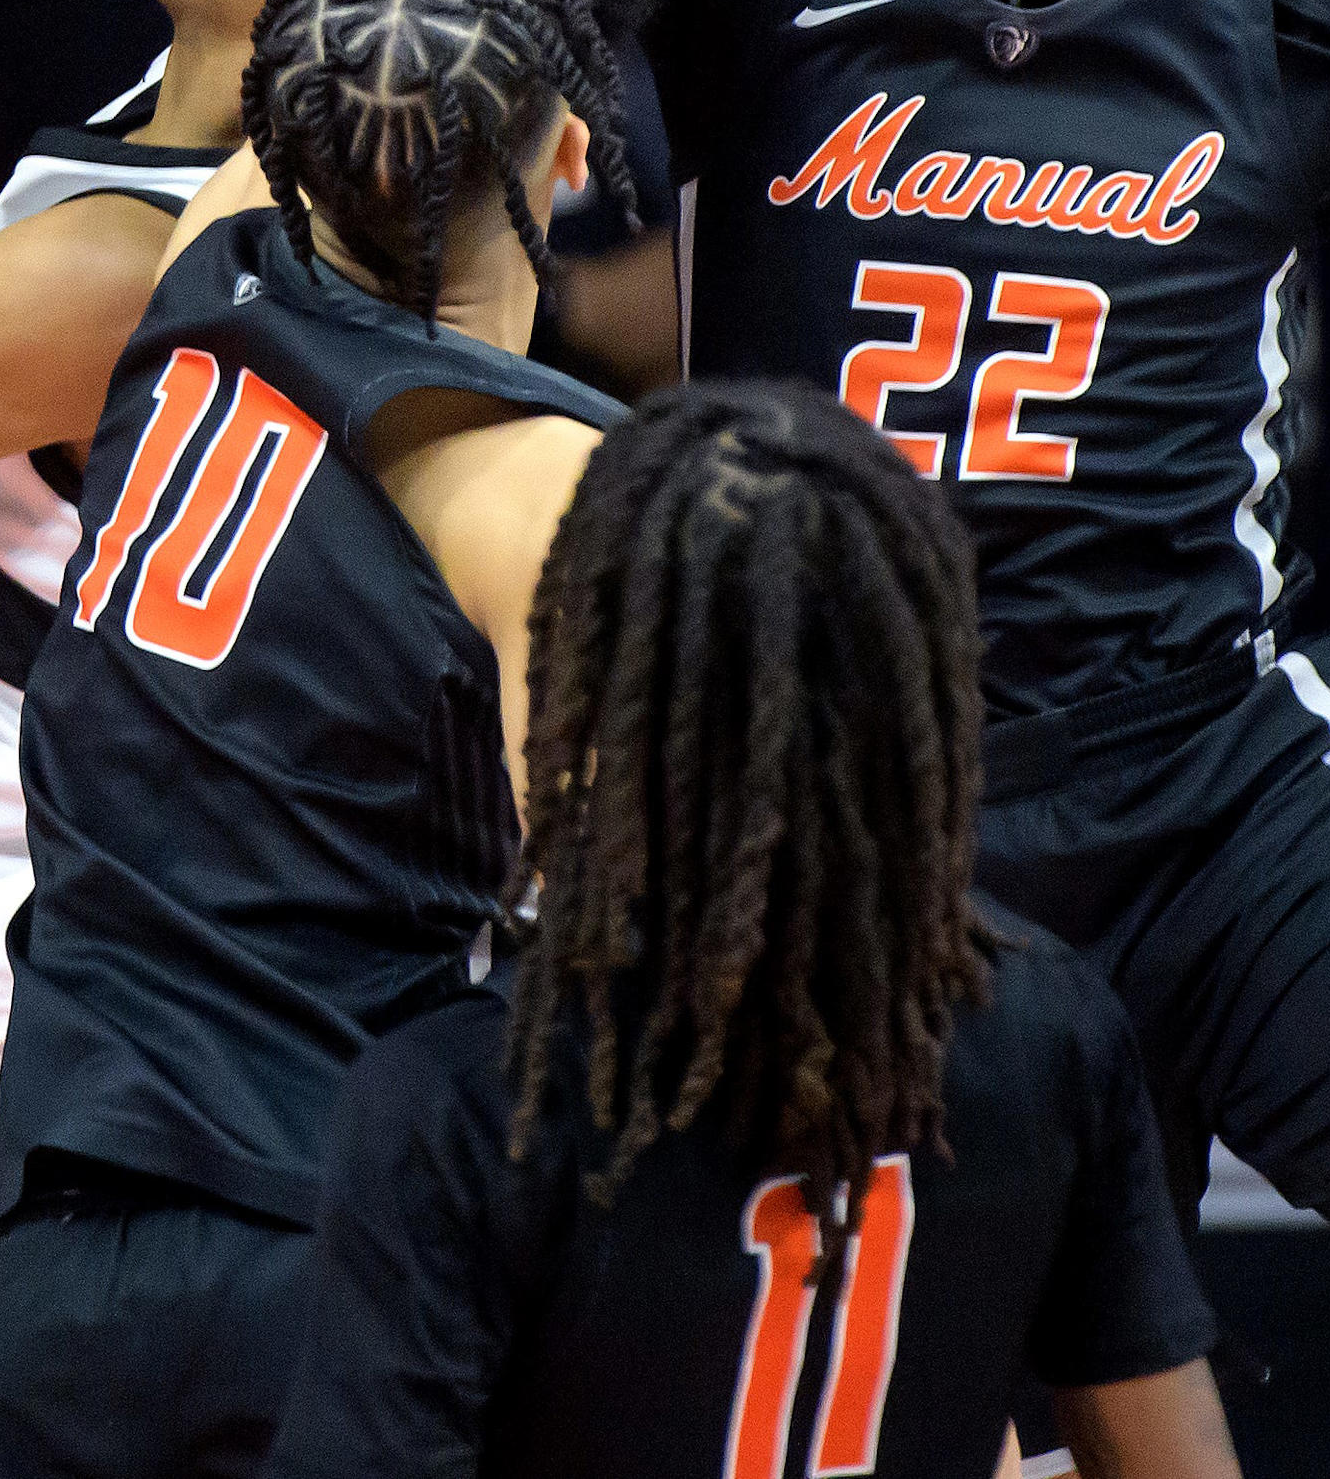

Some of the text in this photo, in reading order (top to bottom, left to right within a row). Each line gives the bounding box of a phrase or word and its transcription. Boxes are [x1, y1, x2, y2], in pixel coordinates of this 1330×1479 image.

[769, 92, 1226, 246] Manual
[838, 259, 1111, 482] 22
[72, 347, 329, 671] 10
[722, 1152, 916, 1479] 11
